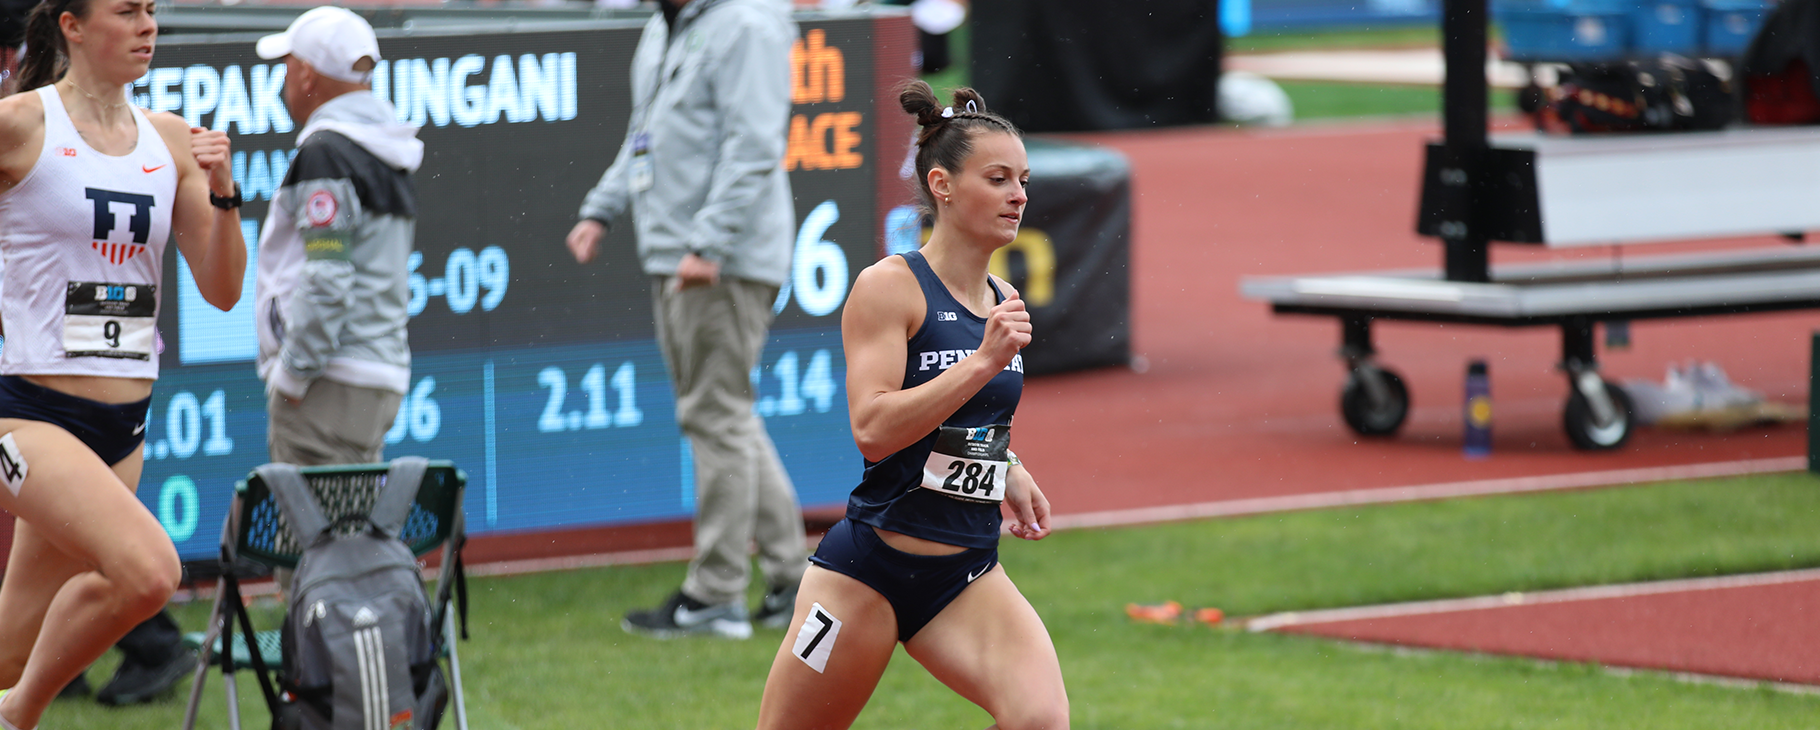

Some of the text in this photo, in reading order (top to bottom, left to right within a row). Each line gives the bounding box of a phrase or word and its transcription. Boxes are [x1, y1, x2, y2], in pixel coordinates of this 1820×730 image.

[773, 199, 849, 316] 6
[104, 319, 121, 348] 9
[143, 389, 235, 460] .01
[537, 361, 644, 433] 2.11
[749, 349, 838, 417] .14
[0, 443, 22, 483] 4
[942, 460, 996, 496] 284
[801, 609, 833, 660] 7
